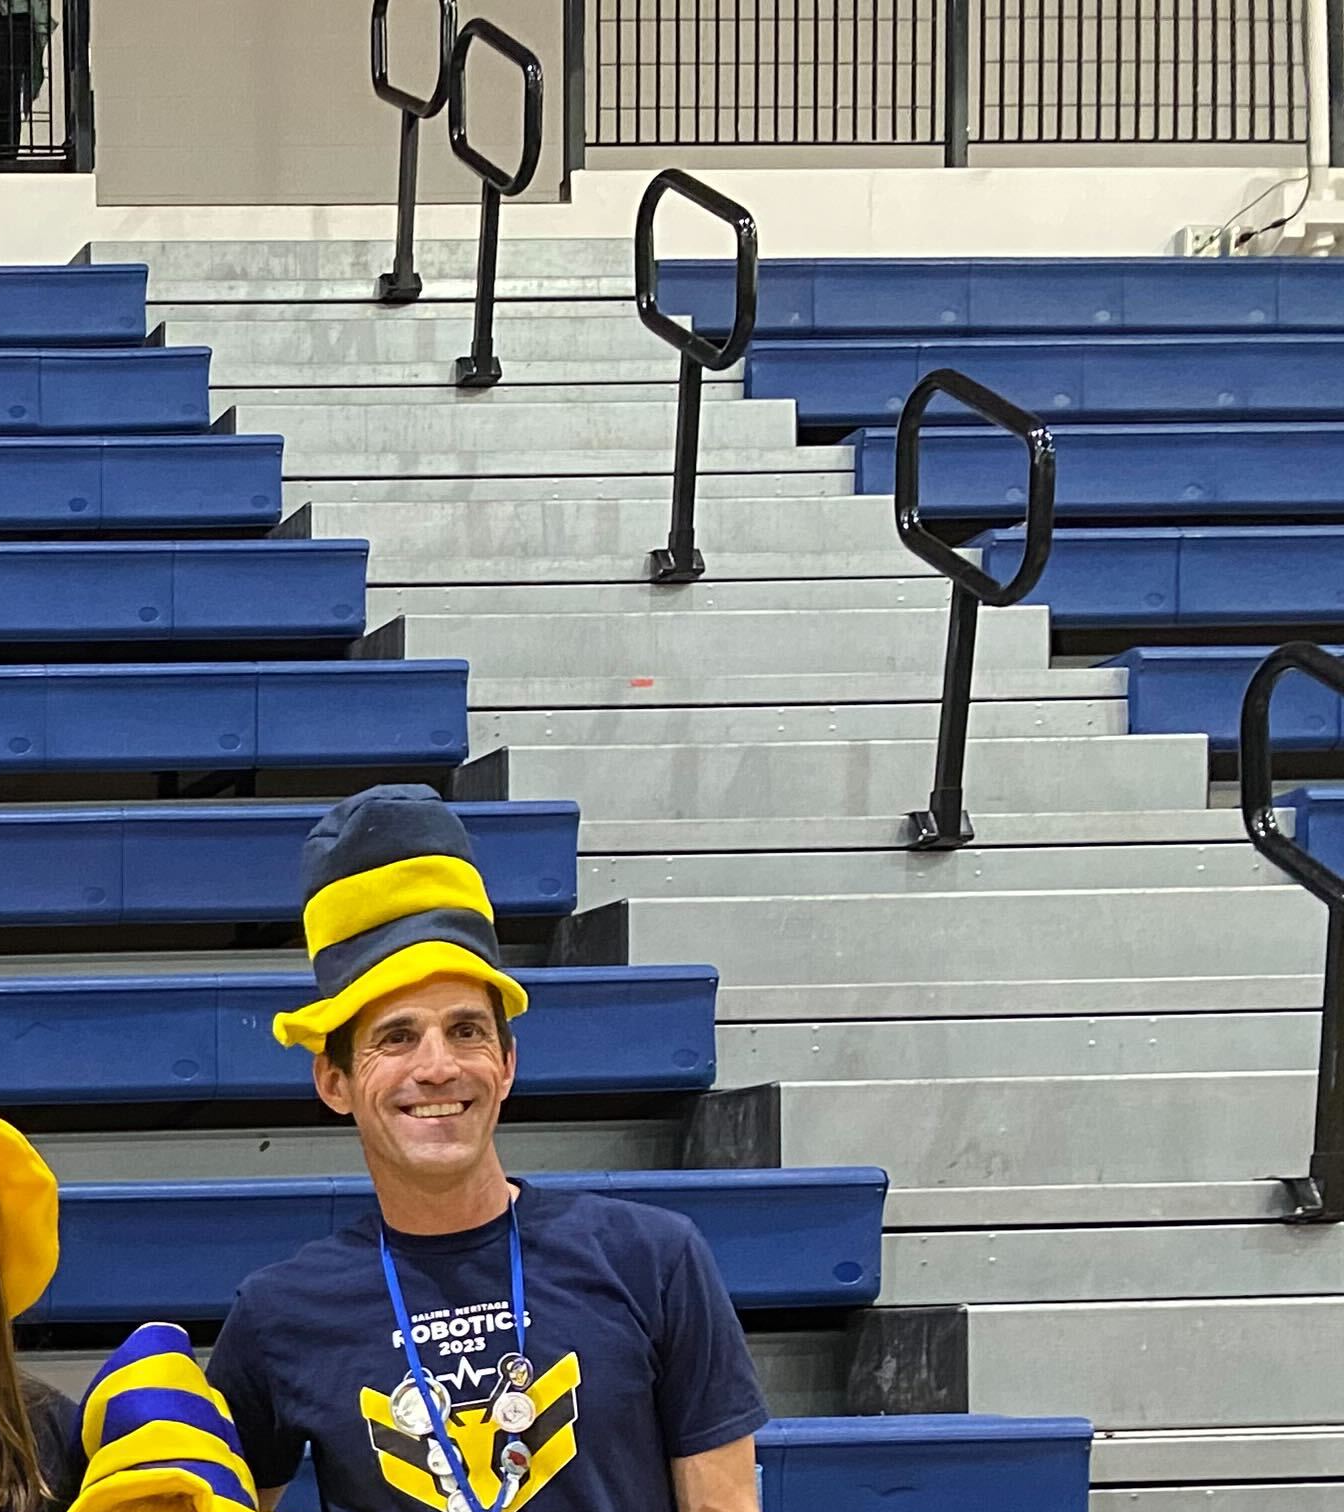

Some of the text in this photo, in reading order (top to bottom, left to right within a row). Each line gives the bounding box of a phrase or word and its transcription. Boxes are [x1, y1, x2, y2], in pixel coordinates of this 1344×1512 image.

[411, 1301, 509, 1323] SALINE HERITAGE
[392, 1311, 531, 1348] ROBOTICS
[439, 1337, 486, 1356] 2023
